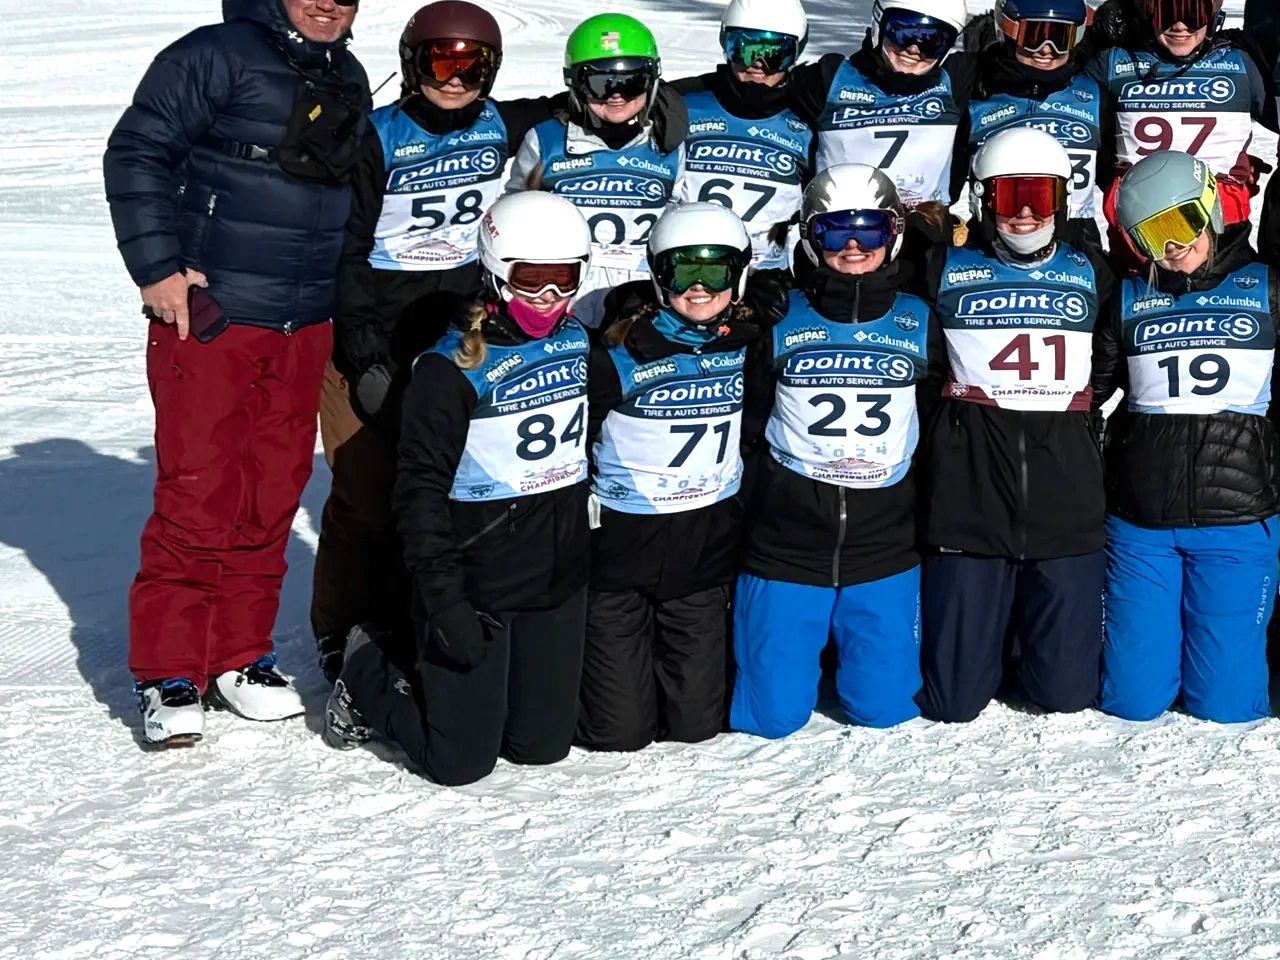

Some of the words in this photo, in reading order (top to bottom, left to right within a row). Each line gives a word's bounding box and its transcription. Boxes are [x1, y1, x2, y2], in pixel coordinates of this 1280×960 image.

[1194, 60, 1239, 70] Columbia
[1128, 81, 1197, 97] point
[1212, 81, 1229, 97] S
[926, 102, 941, 114] S
[1052, 102, 1094, 122] Columbia
[460, 131, 502, 143] Columbia
[760, 129, 802, 152] Columbia
[1134, 116, 1217, 156] 97
[695, 144, 764, 162] point
[777, 154, 792, 170] S
[874, 130, 909, 169] 7
[399, 155, 469, 184] point
[481, 152, 495, 169] S
[630, 158, 670, 175] Columbia
[737, 168, 770, 177] SERVICE
[422, 180, 446, 189] AUTO
[448, 176, 478, 185] SERVICE
[408, 190, 483, 231] 58
[698, 178, 777, 222] 67
[1045, 271, 1091, 289] Columbia
[968, 293, 1050, 314] point
[1066, 297, 1083, 316] S
[1210, 296, 1261, 308] Columbia
[1024, 318, 1061, 326] SERVICE
[1144, 318, 1216, 340] point
[1233, 318, 1252, 335] S
[868, 332, 919, 352] Columbia
[794, 355, 874, 373] point
[890, 360, 909, 377] S
[988, 334, 1065, 380] 41
[1158, 354, 1230, 397] 19
[529, 396, 551, 406] AUTO
[553, 388, 580, 400] SERVICE
[650, 382, 722, 404] point
[735, 376, 743, 398] S
[700, 406, 731, 414] SERVICE
[808, 393, 891, 437] 23
[516, 403, 584, 461] 84
[667, 420, 731, 468] 71
